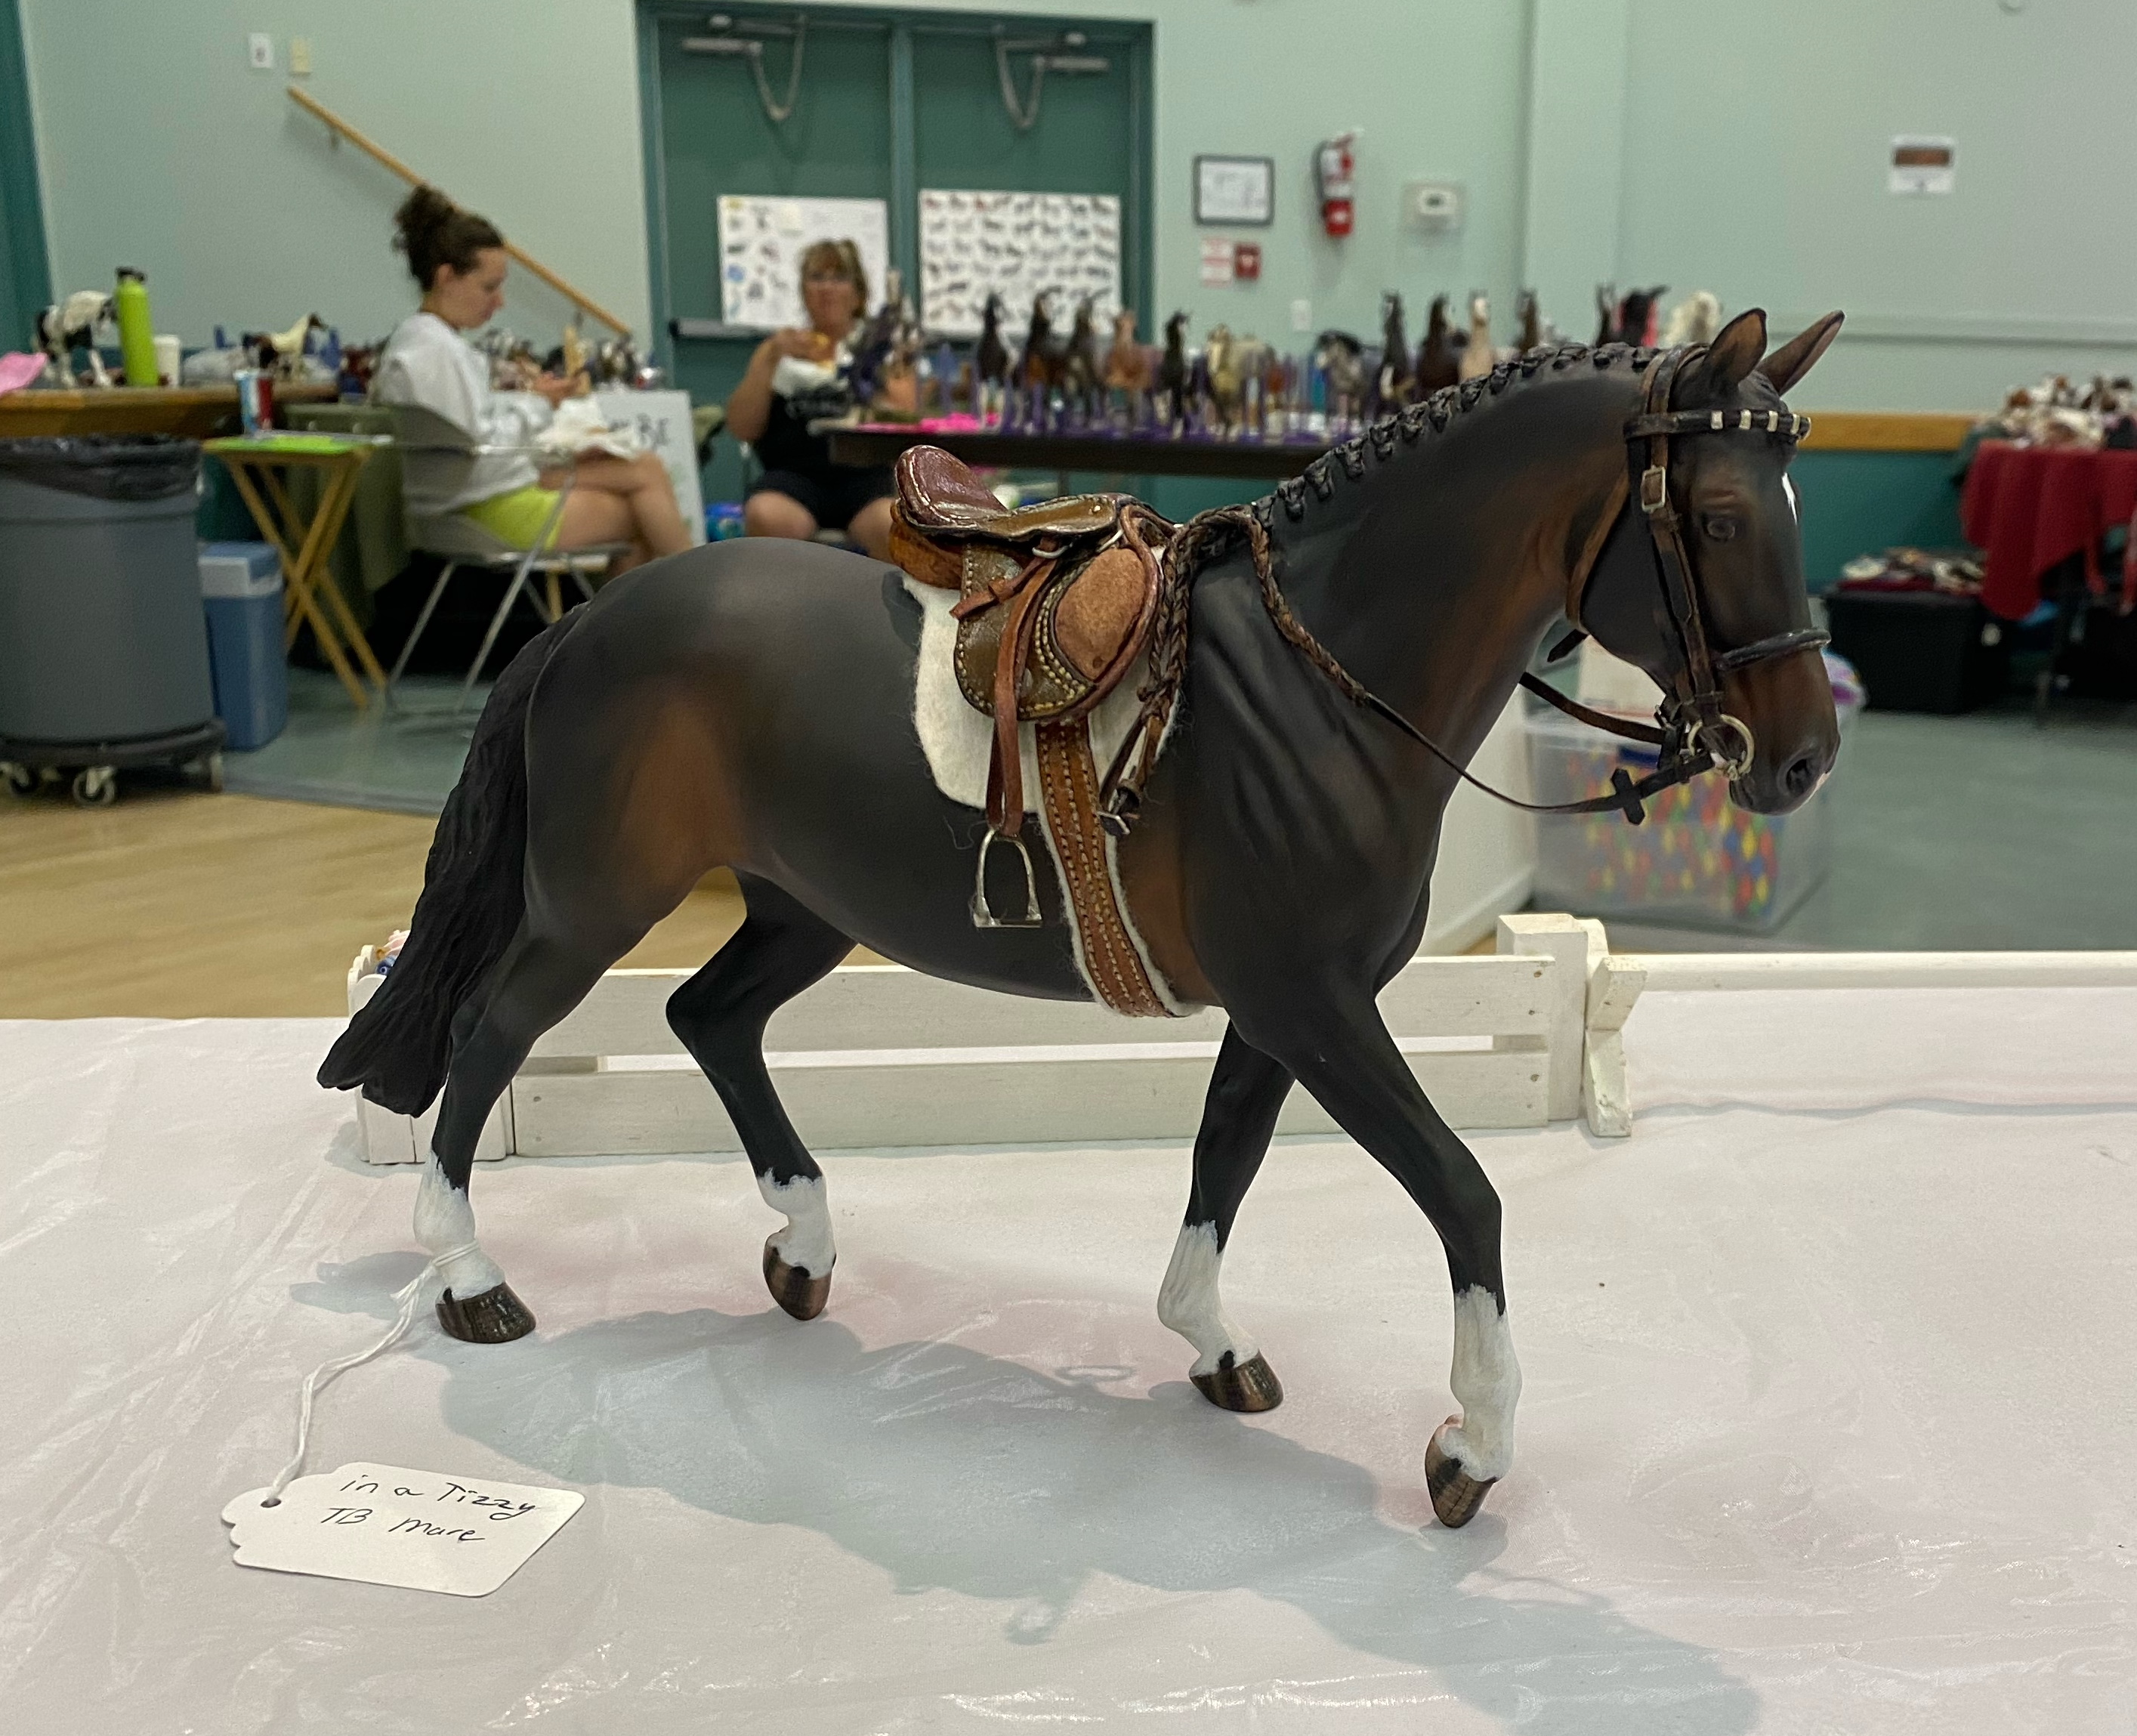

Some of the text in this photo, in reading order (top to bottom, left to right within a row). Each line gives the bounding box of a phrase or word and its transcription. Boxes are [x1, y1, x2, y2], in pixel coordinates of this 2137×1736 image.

[339, 1474, 537, 1521] in a Tizzy
[320, 1507, 373, 1525] TB
